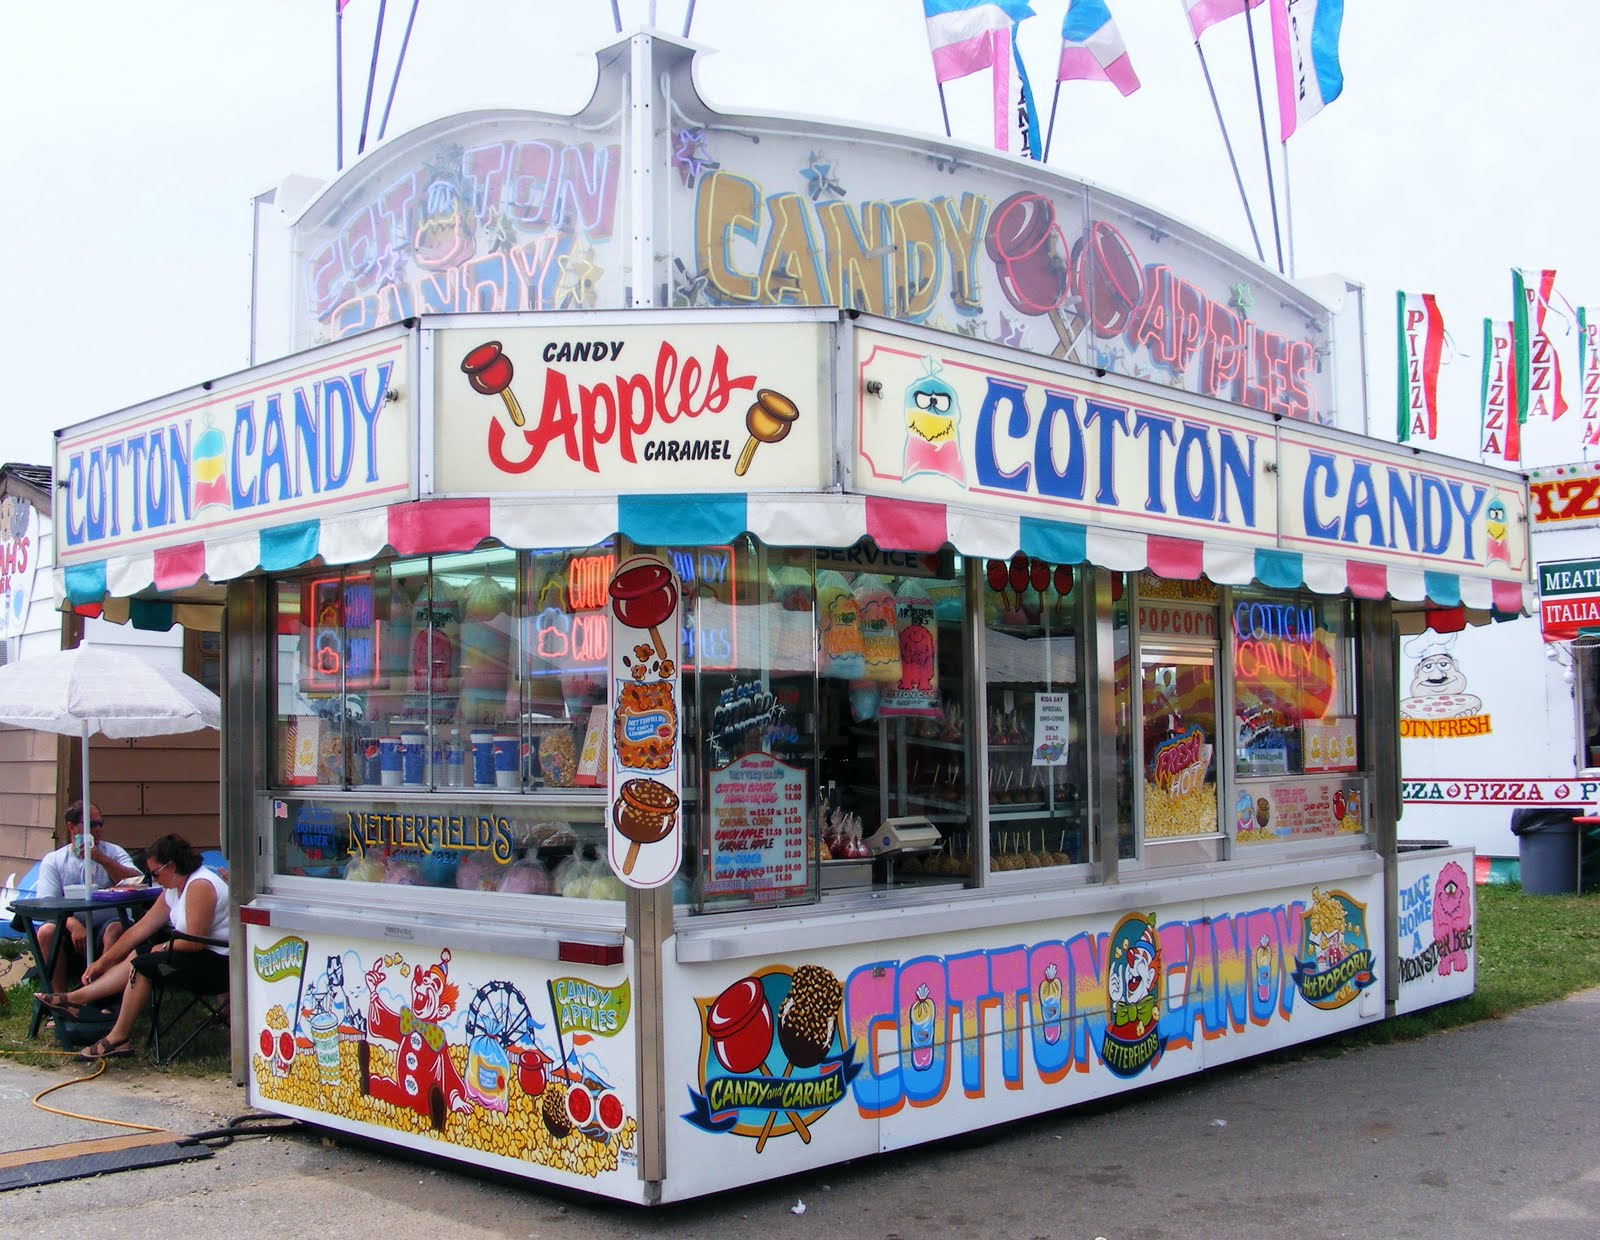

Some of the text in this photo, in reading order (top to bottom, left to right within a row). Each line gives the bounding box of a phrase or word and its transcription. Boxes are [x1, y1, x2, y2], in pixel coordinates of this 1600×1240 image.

[304, 139, 620, 325] COTTON
[695, 170, 990, 323] CANDY
[543, 341, 624, 362] CANDY
[1122, 263, 1320, 424] APPLES
[1524, 288, 1551, 416] PZZA
[1406, 310, 1426, 435] PIZZA
[488, 340, 757, 474] Apples
[1482, 337, 1509, 455] PIZZA
[66, 360, 395, 546] COTTON CANDY
[644, 439, 731, 461] CARAMEL
[975, 377, 1257, 527] COTTON
[1303, 449, 1488, 560] CANDY
[1236, 602, 1314, 643] COTTON
[1546, 602, 1600, 624] ITALIA
[1240, 641, 1314, 678] CANDY
[1170, 761, 1203, 799] HOT
[1402, 783, 1444, 800] ZZA
[1463, 783, 1544, 801] PIZZA
[346, 811, 514, 864] NETTERFIELD'S
[750, 838, 774, 850] APPLE
[1399, 873, 1432, 912] TAKE
[1399, 900, 1432, 937] HOME
[1412, 930, 1423, 955] A
[556, 980, 611, 1009] CANDY
[1303, 951, 1368, 998] Hot POPCORN
[561, 1004, 618, 1032] APPLES
[846, 901, 1308, 1119] COTTON CANDY
[1103, 1033, 1158, 1070] NETTERFIELD'S
[711, 1075, 843, 1110] CANDY and CARMEL
